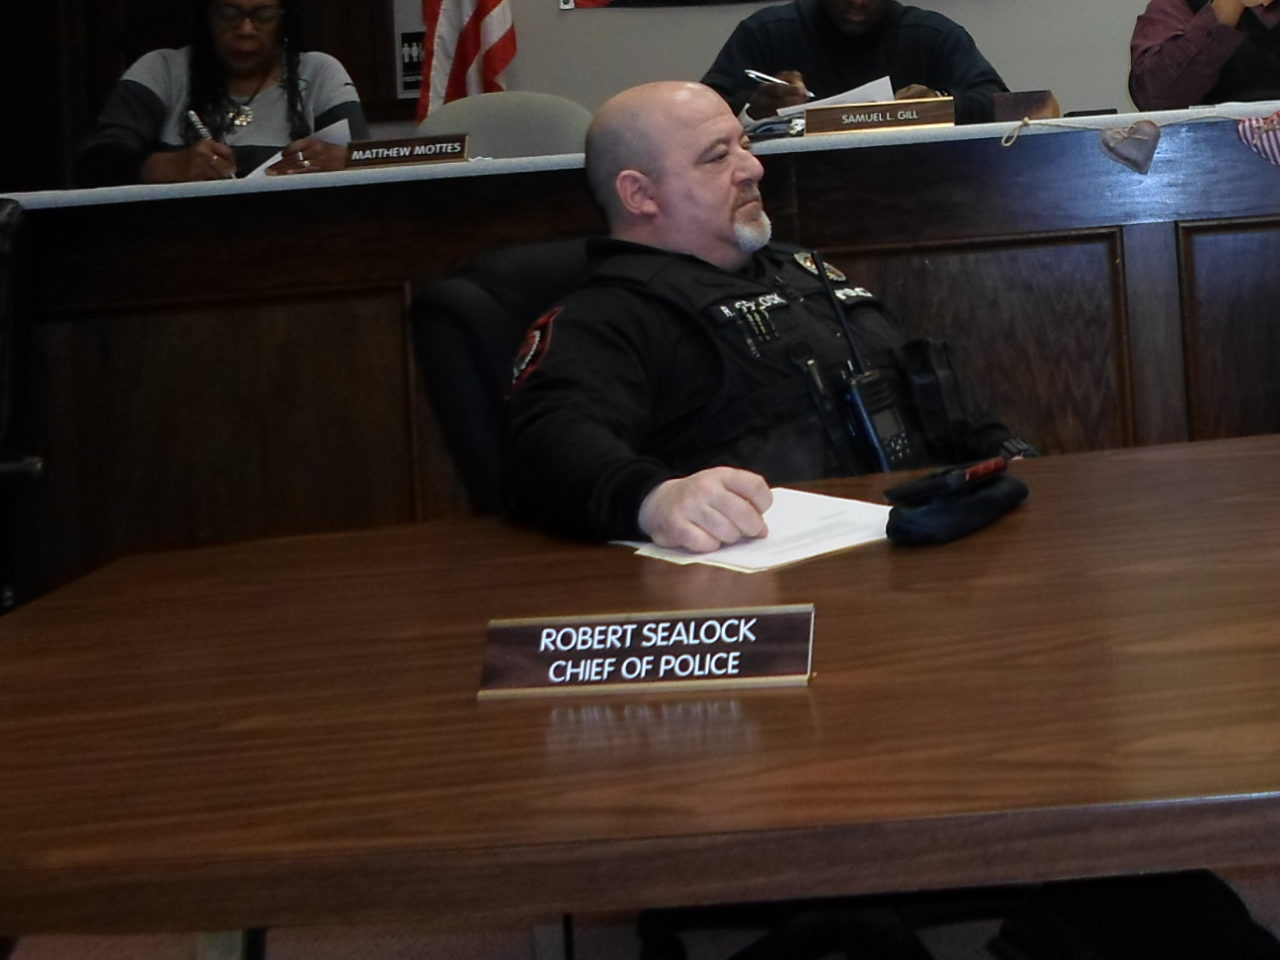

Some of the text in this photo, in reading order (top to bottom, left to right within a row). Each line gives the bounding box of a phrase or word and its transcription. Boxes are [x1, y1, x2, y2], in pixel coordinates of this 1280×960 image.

[842, 110, 918, 124] SAMUEL L. GILL
[351, 142, 461, 161] MATTHEW MOTTES
[539, 619, 757, 652] ROBERT SEALOCK
[548, 652, 741, 682] CHIEF OF POLICE
